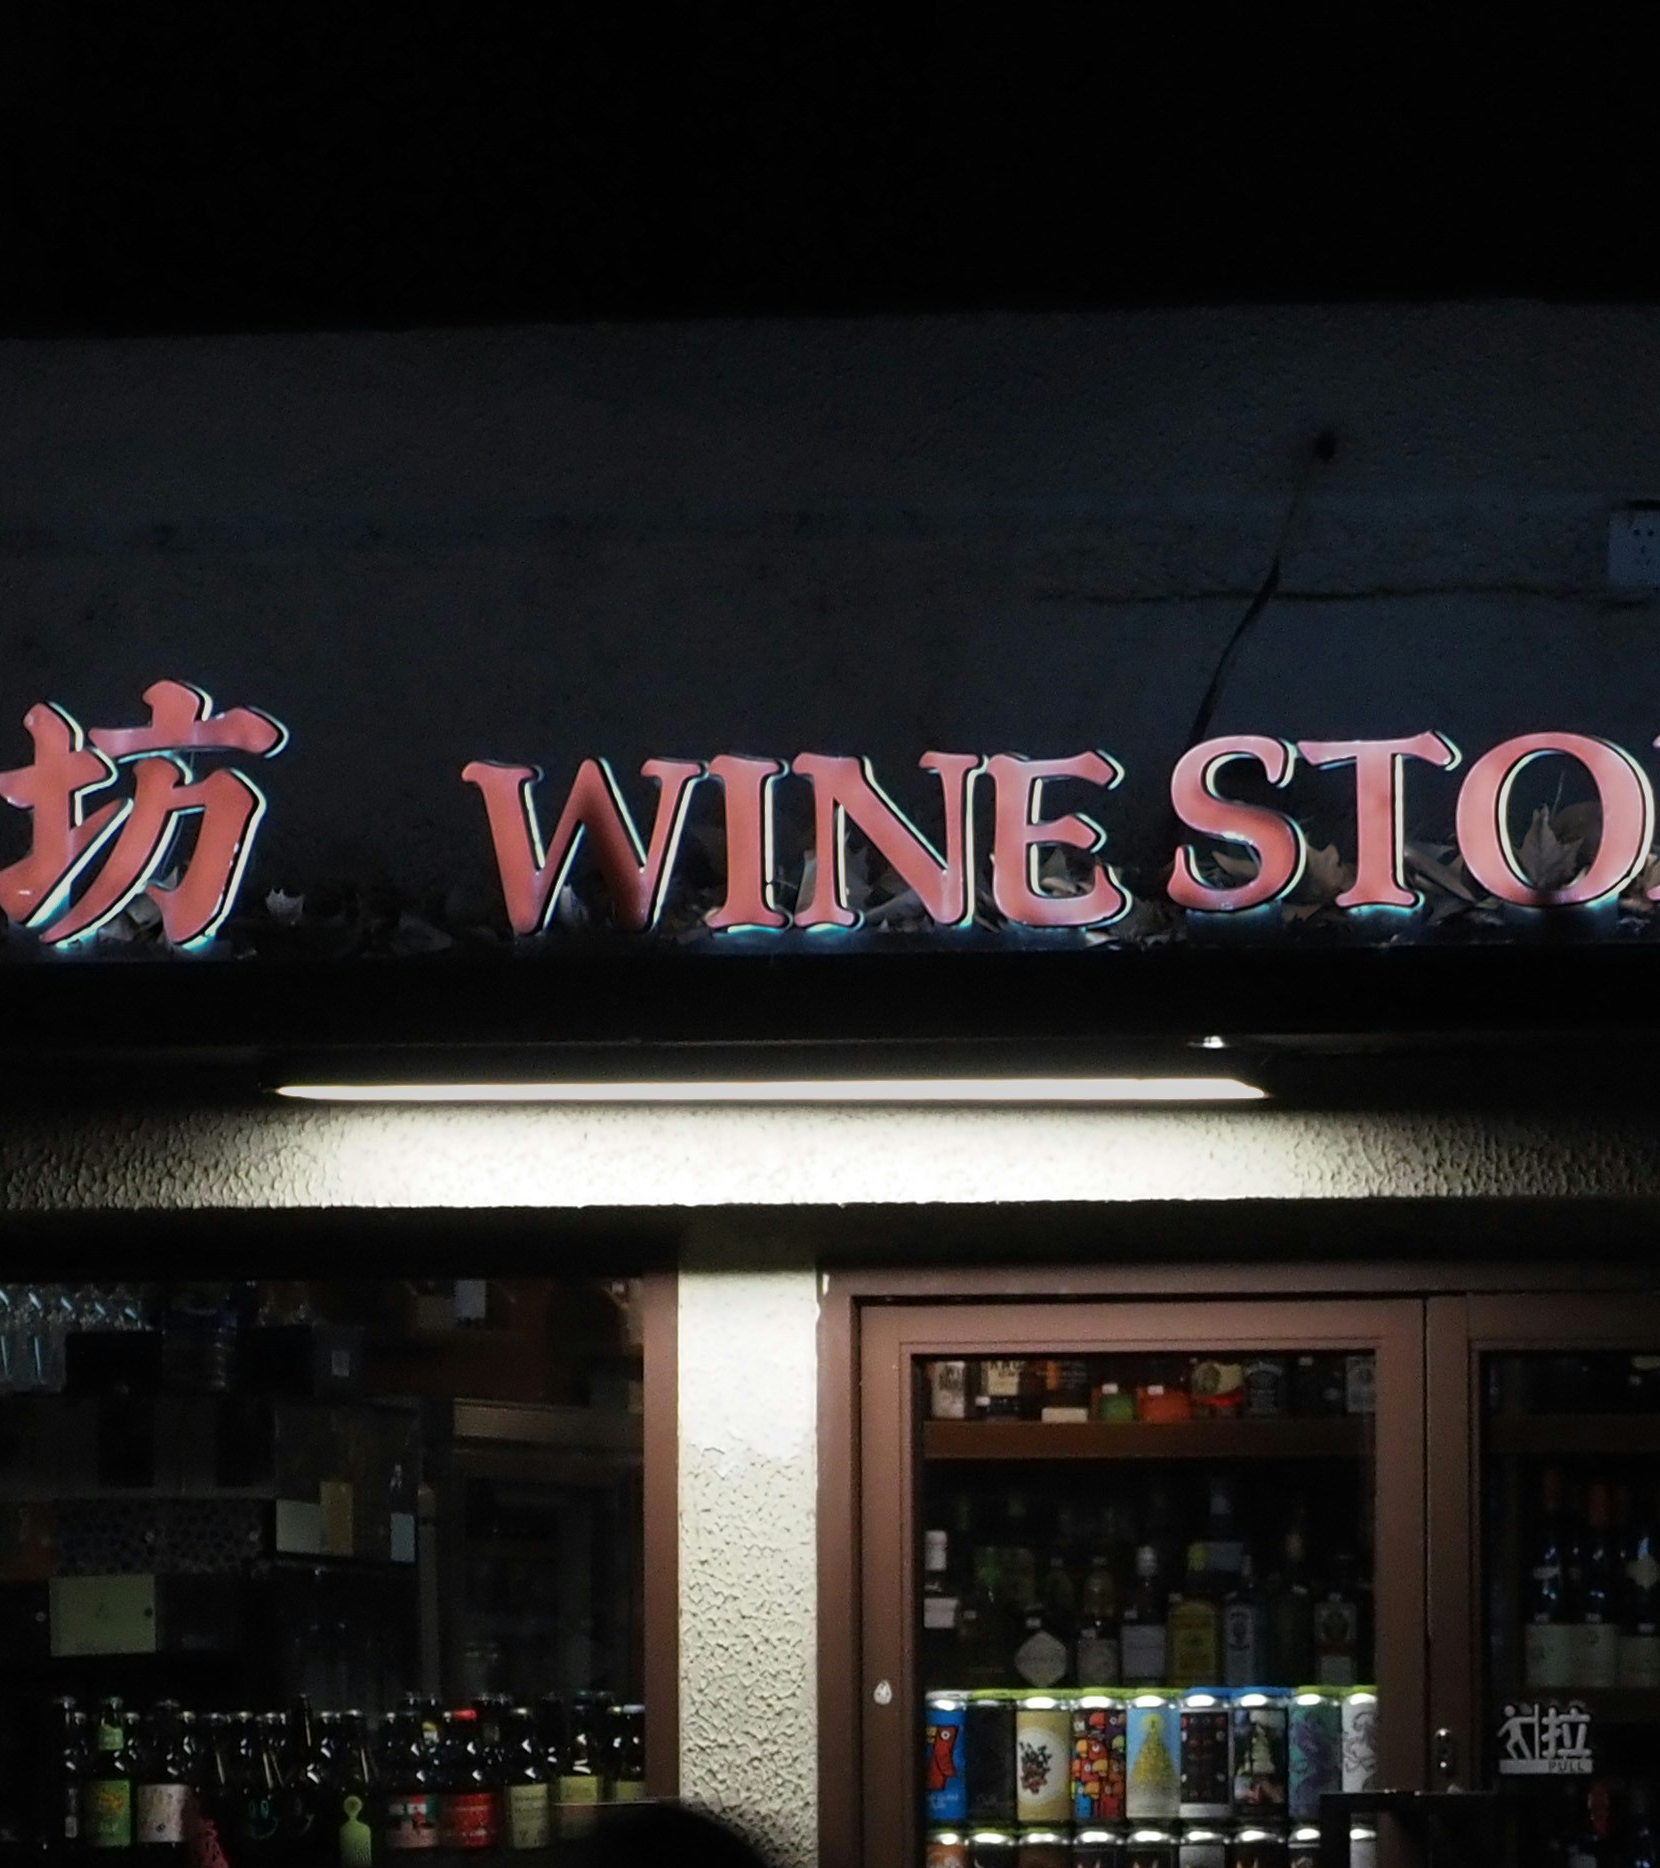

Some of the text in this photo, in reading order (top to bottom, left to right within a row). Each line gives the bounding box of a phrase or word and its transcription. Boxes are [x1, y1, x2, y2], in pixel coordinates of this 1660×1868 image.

[461, 752, 1132, 938] WINE
[1541, 1706, 1593, 1759] 拉
[1548, 1760, 1584, 1772] PULL
